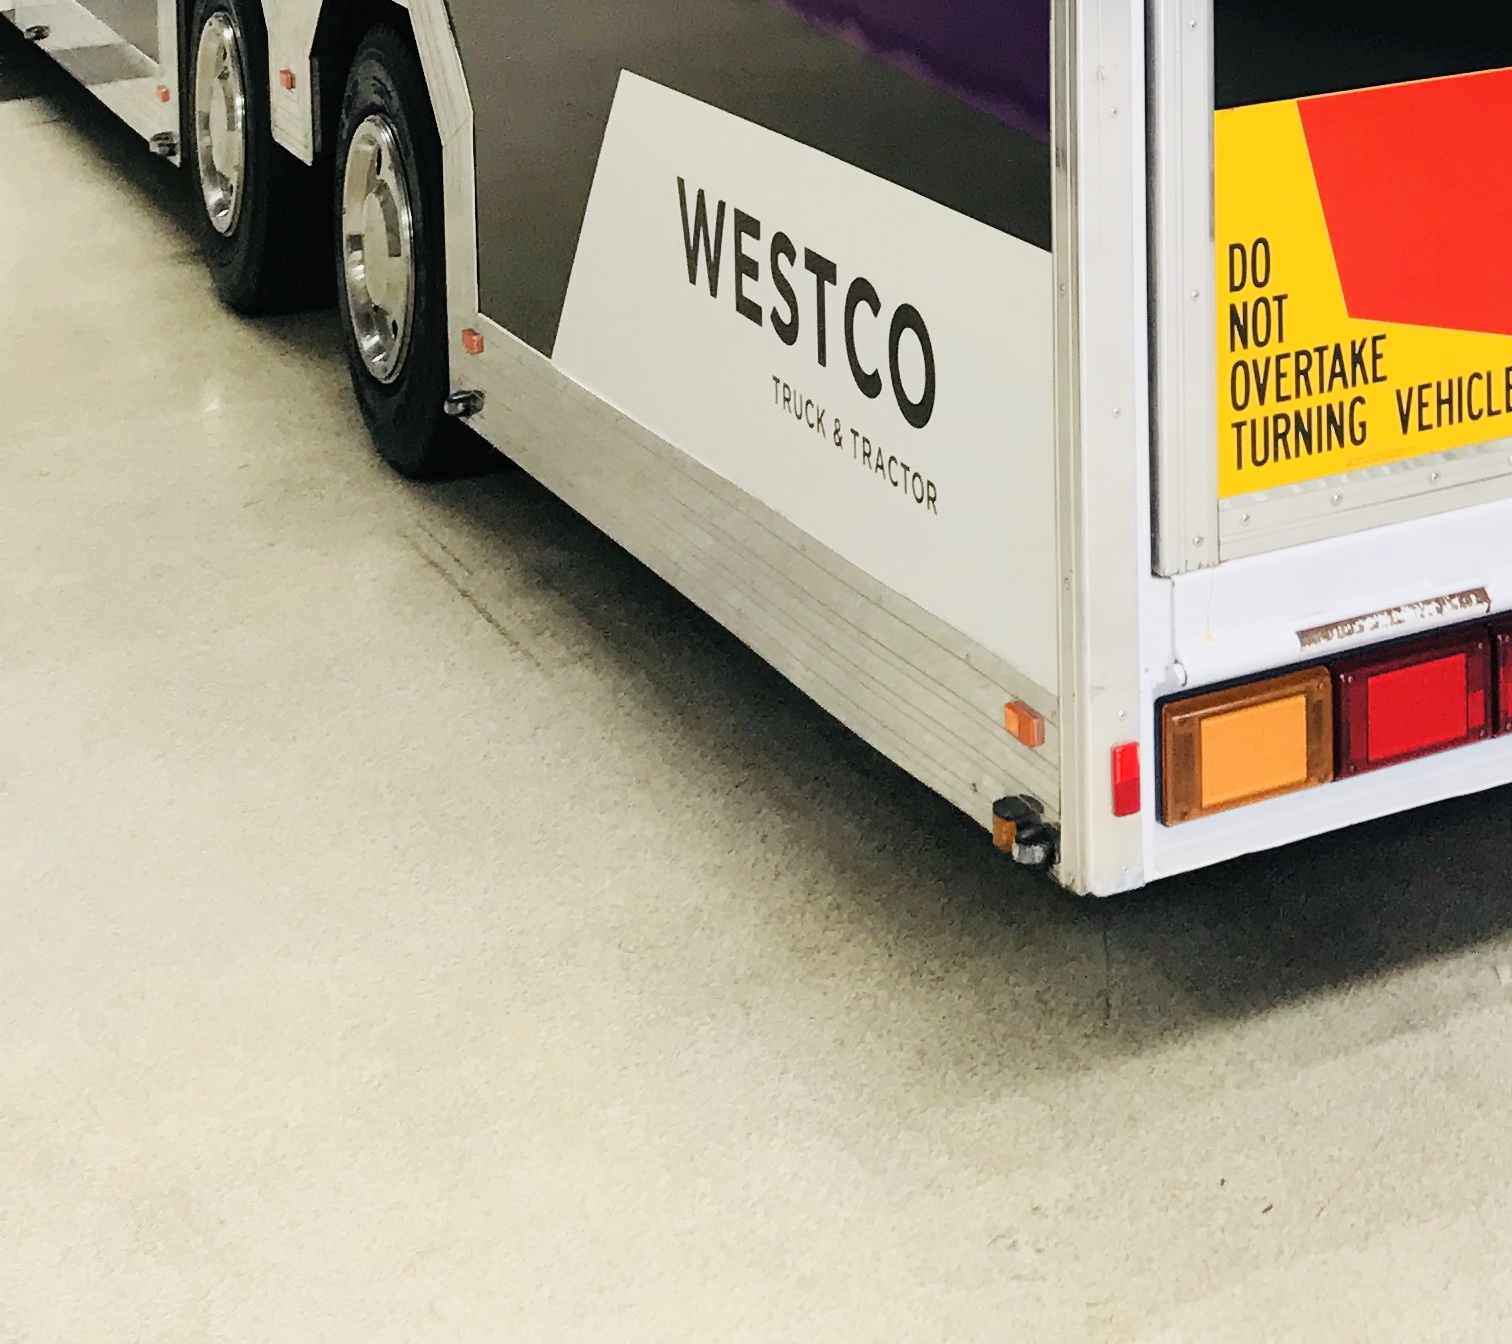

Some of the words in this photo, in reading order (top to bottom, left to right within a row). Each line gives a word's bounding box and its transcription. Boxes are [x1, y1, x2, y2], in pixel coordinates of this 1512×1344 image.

[677, 176, 936, 429] WESTCO
[1228, 237, 1271, 294] DO
[1229, 293, 1289, 353] NOT
[1230, 333, 1388, 412] OVERTAKE
[772, 374, 827, 439] TRUCK
[832, 417, 844, 449] &
[850, 427, 938, 515] TRACTOR
[1231, 396, 1367, 471] TURNING
